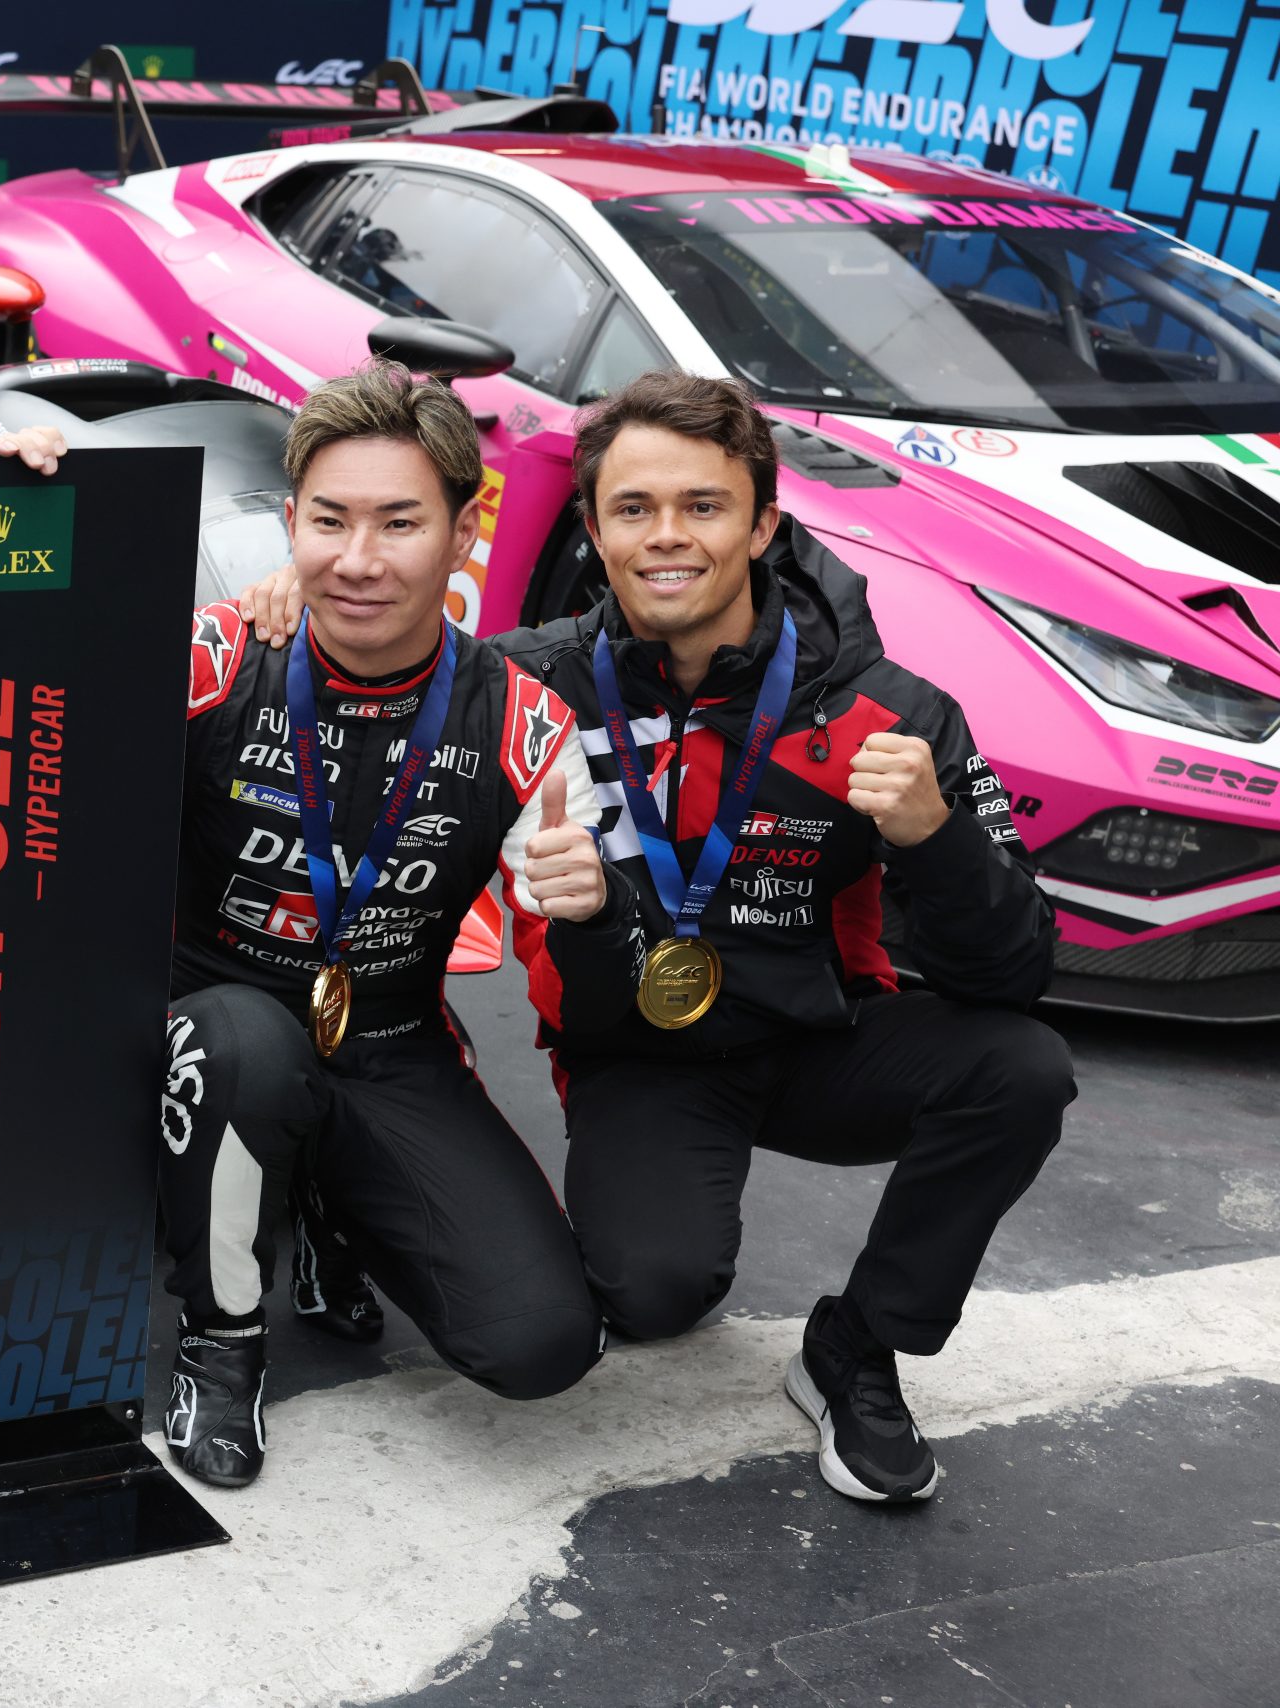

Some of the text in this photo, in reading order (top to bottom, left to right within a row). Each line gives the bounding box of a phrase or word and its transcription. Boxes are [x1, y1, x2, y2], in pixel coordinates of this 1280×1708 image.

[275, 58, 364, 86] WEC
[659, 64, 1078, 156] FIA WORLD ENDURANCE
[726, 197, 1137, 234] IRON DAMES
[338, 702, 380, 717] GR
[255, 705, 345, 750] FUJSU
[239, 743, 341, 784] AISN
[385, 739, 457, 770] Mbil
[606, 708, 640, 788] HYPERPOLE
[734, 711, 771, 794] HYPERPOLE
[966, 753, 989, 774] AIS
[24, 684, 66, 864] HYPERCAR
[295, 726, 318, 809] HYPERPOLE
[384, 745, 423, 827] HYPERPOLE
[971, 773, 1004, 797] ZEN
[260, 792, 301, 812] MICHE
[977, 798, 1010, 816] RAY
[403, 813, 462, 837] EC
[774, 828, 823, 842] Racing
[777, 822, 827, 834] GAZOO
[781, 816, 834, 828] TOYOTA
[729, 845, 822, 867] DENSO
[730, 867, 814, 903] FUJITSU
[222, 886, 319, 942] GR
[730, 904, 792, 927] Mobil
[217, 928, 322, 972] RACING
